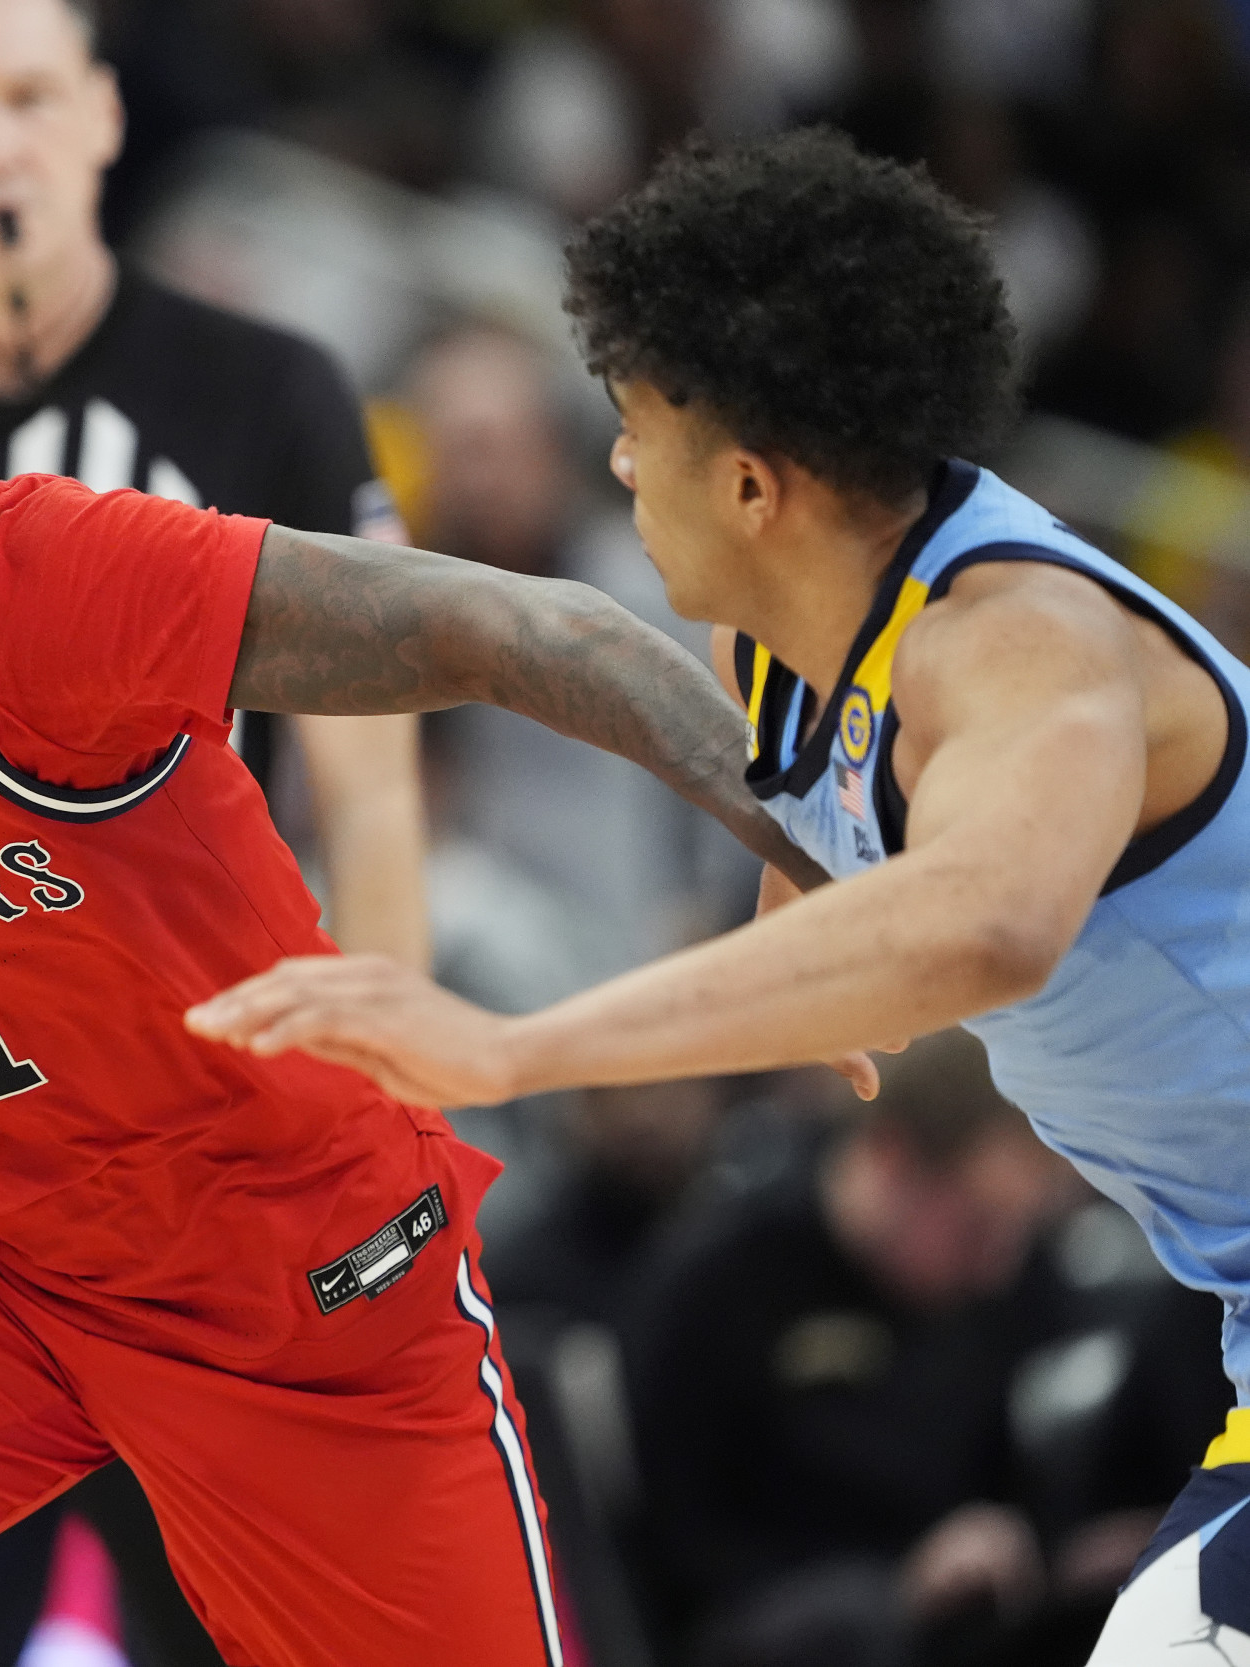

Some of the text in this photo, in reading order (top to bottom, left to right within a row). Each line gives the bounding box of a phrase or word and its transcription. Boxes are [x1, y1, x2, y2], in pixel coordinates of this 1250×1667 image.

[411, 1211, 432, 1238] 46
[351, 1225, 398, 1263] ENGINEERED
[325, 1280, 357, 1303] TEAM
